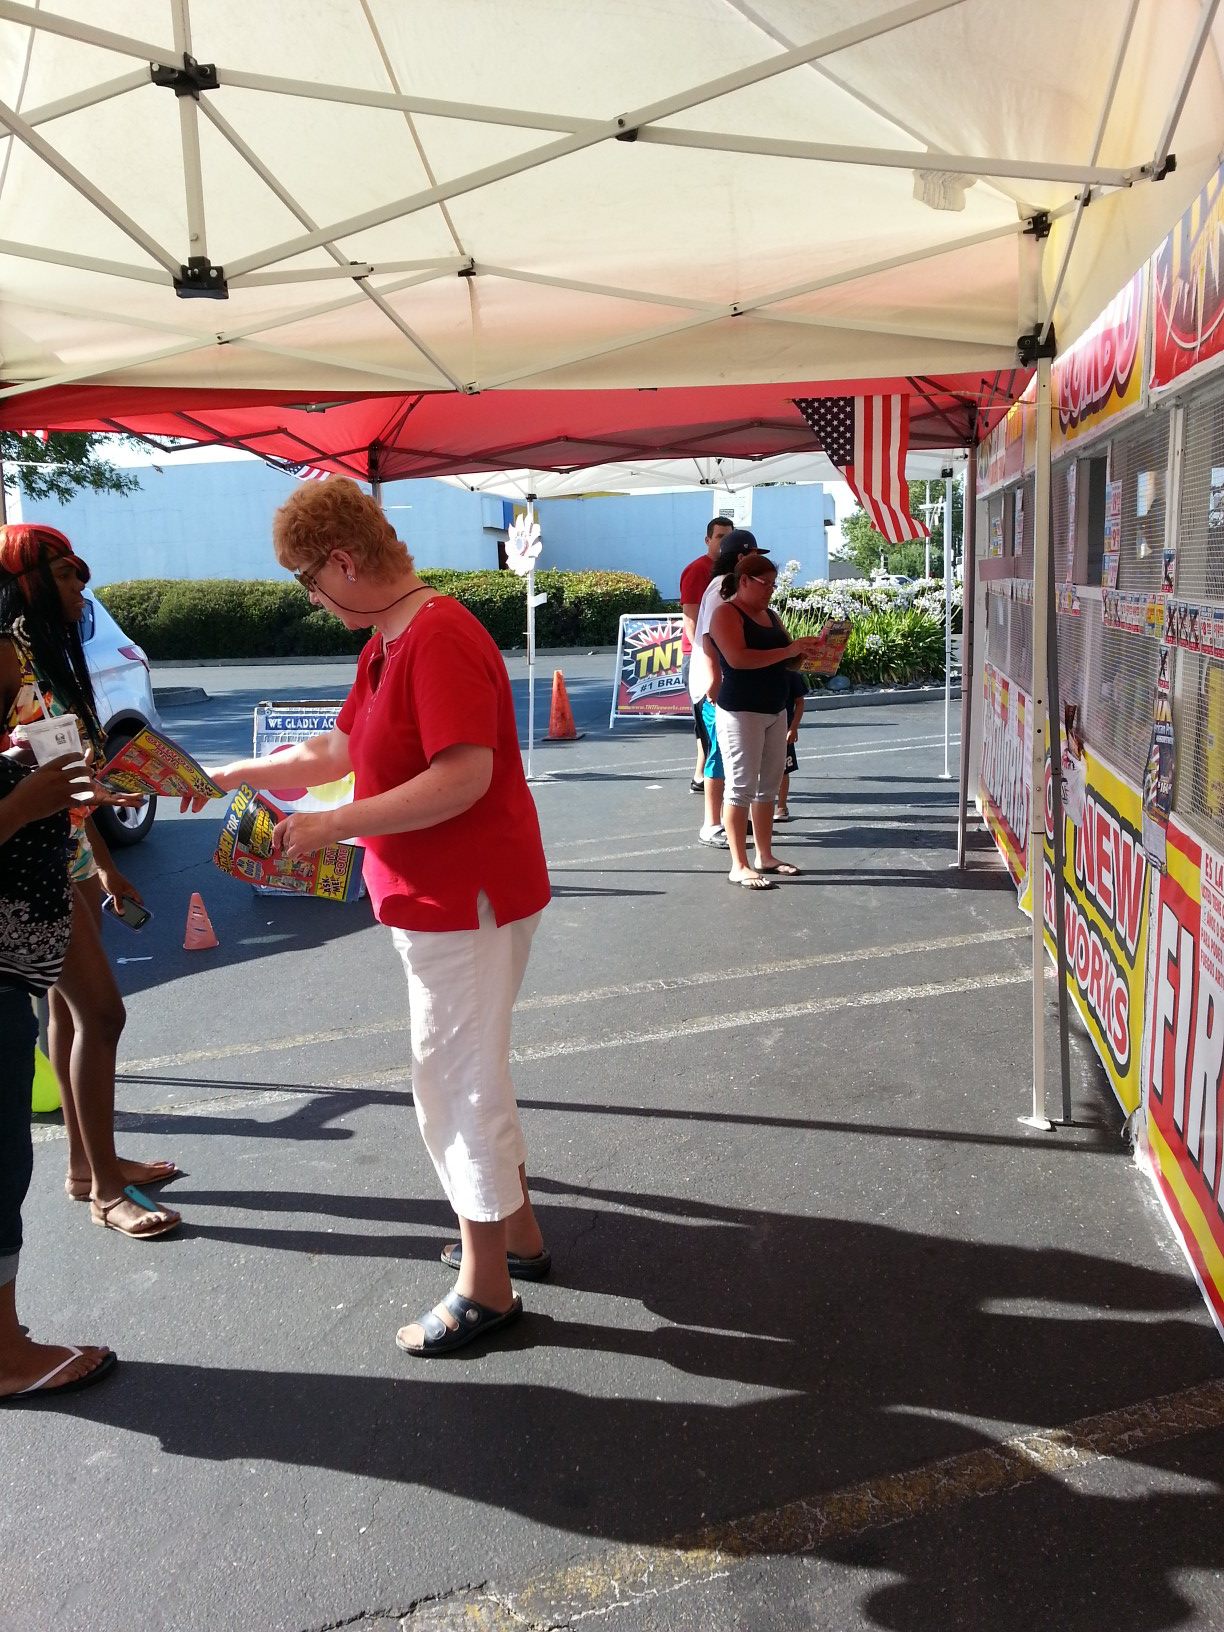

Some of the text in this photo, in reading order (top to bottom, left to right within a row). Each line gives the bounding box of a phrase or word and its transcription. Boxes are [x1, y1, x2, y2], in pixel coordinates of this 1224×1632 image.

[636, 639, 684, 678] TNT
[640, 682, 653, 692] #1
[268, 718, 337, 729] WE GLADLY AC
[230, 783, 254, 818] 2013
[226, 814, 240, 835] FOR
[324, 846, 337, 865] TNT
[1075, 793, 1147, 957] NEW
[1205, 851, 1224, 891] ES LA
[322, 878, 331, 893] ASK
[1152, 902, 1224, 1216] FIR
